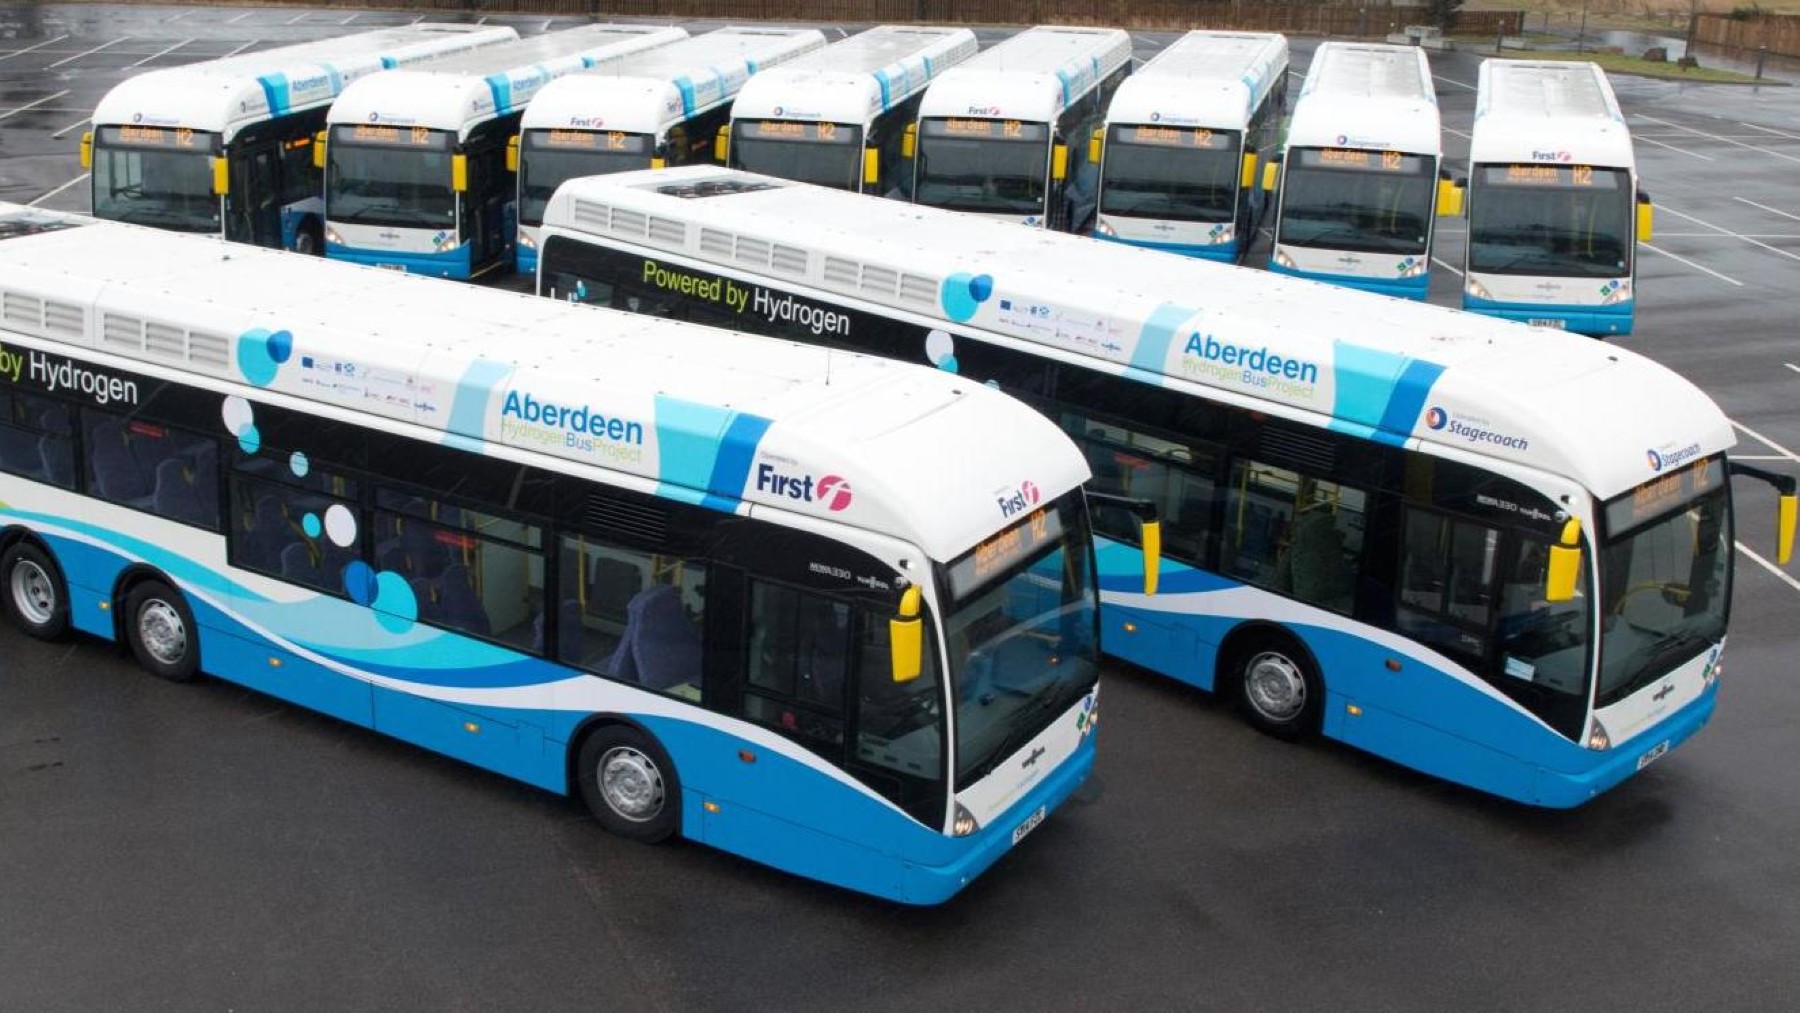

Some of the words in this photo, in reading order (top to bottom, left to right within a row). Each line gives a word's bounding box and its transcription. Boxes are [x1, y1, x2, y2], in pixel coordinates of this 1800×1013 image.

[968, 106, 988, 115] First
[570, 117, 590, 127] First
[817, 121, 836, 141] H2
[1003, 119, 1022, 138] H2
[176, 127, 194, 147] H2
[411, 126, 430, 146] H2
[607, 131, 626, 150] H2
[1194, 128, 1213, 147] H2
[1382, 151, 1401, 171] H2
[1532, 150, 1556, 161] First
[1572, 165, 1592, 186] H2
[642, 260, 721, 301] Powered
[725, 284, 749, 314] by
[753, 287, 850, 336] Hydrogen
[1184, 331, 1318, 383] Aberdeen
[0, 343, 23, 382] by
[30, 350, 138, 405] Hydrogen
[502, 389, 643, 445] Aberdeen
[1447, 420, 1529, 451] Stagecoach
[757, 463, 813, 502] First
[997, 489, 1027, 518] First
